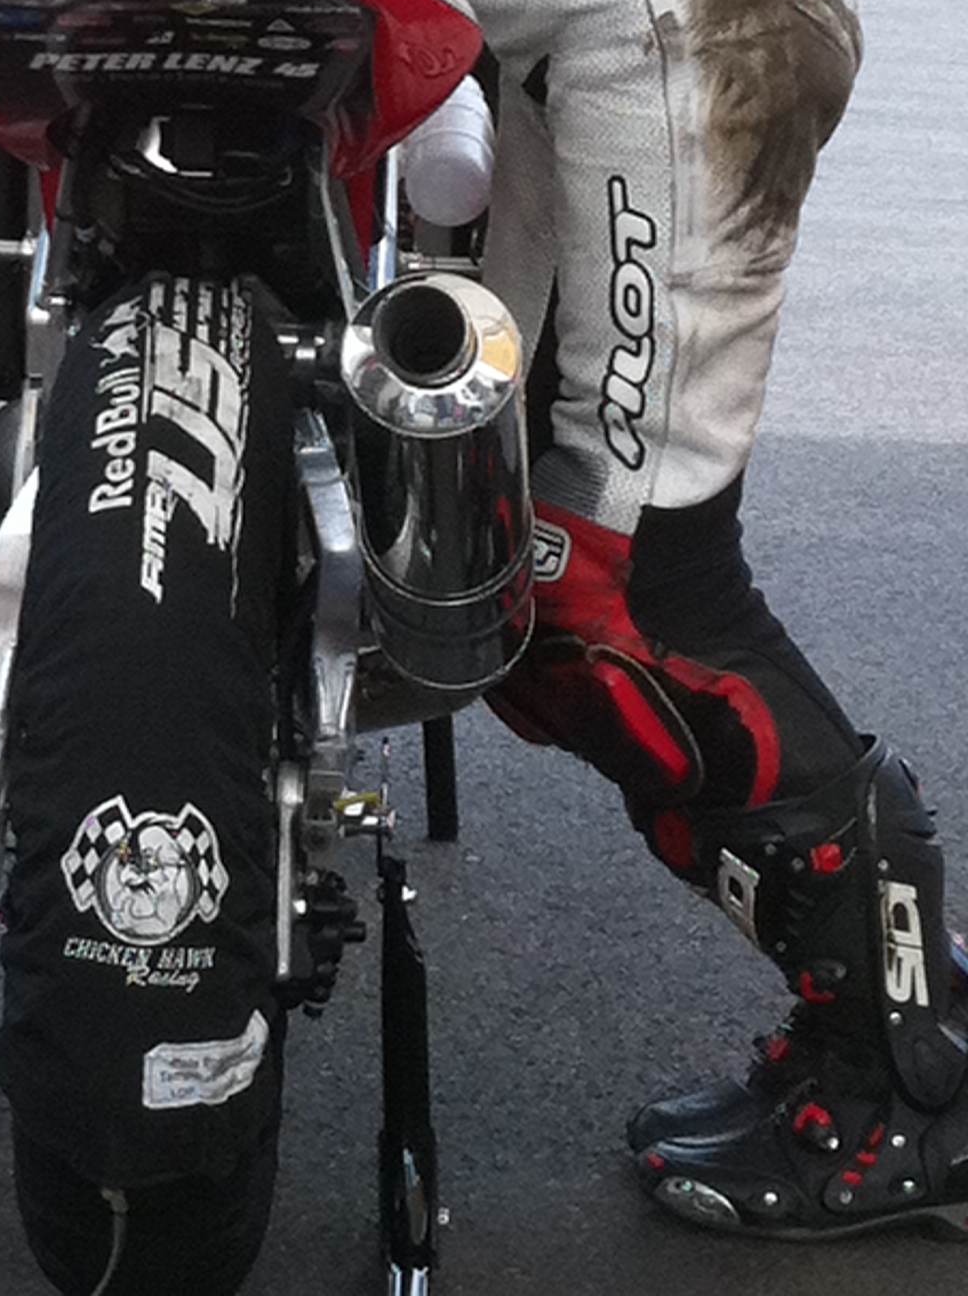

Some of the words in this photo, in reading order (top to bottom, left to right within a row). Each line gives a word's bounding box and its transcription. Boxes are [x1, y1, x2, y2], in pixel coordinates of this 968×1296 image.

[28, 52, 157, 72] PETER
[162, 52, 264, 75] LENZ
[273, 62, 321, 78] 45
[597, 176, 657, 472] PILOT
[63, 937, 152, 968] CHICKEN
[157, 946, 216, 969] HAWK
[126, 964, 200, 993] Racing
